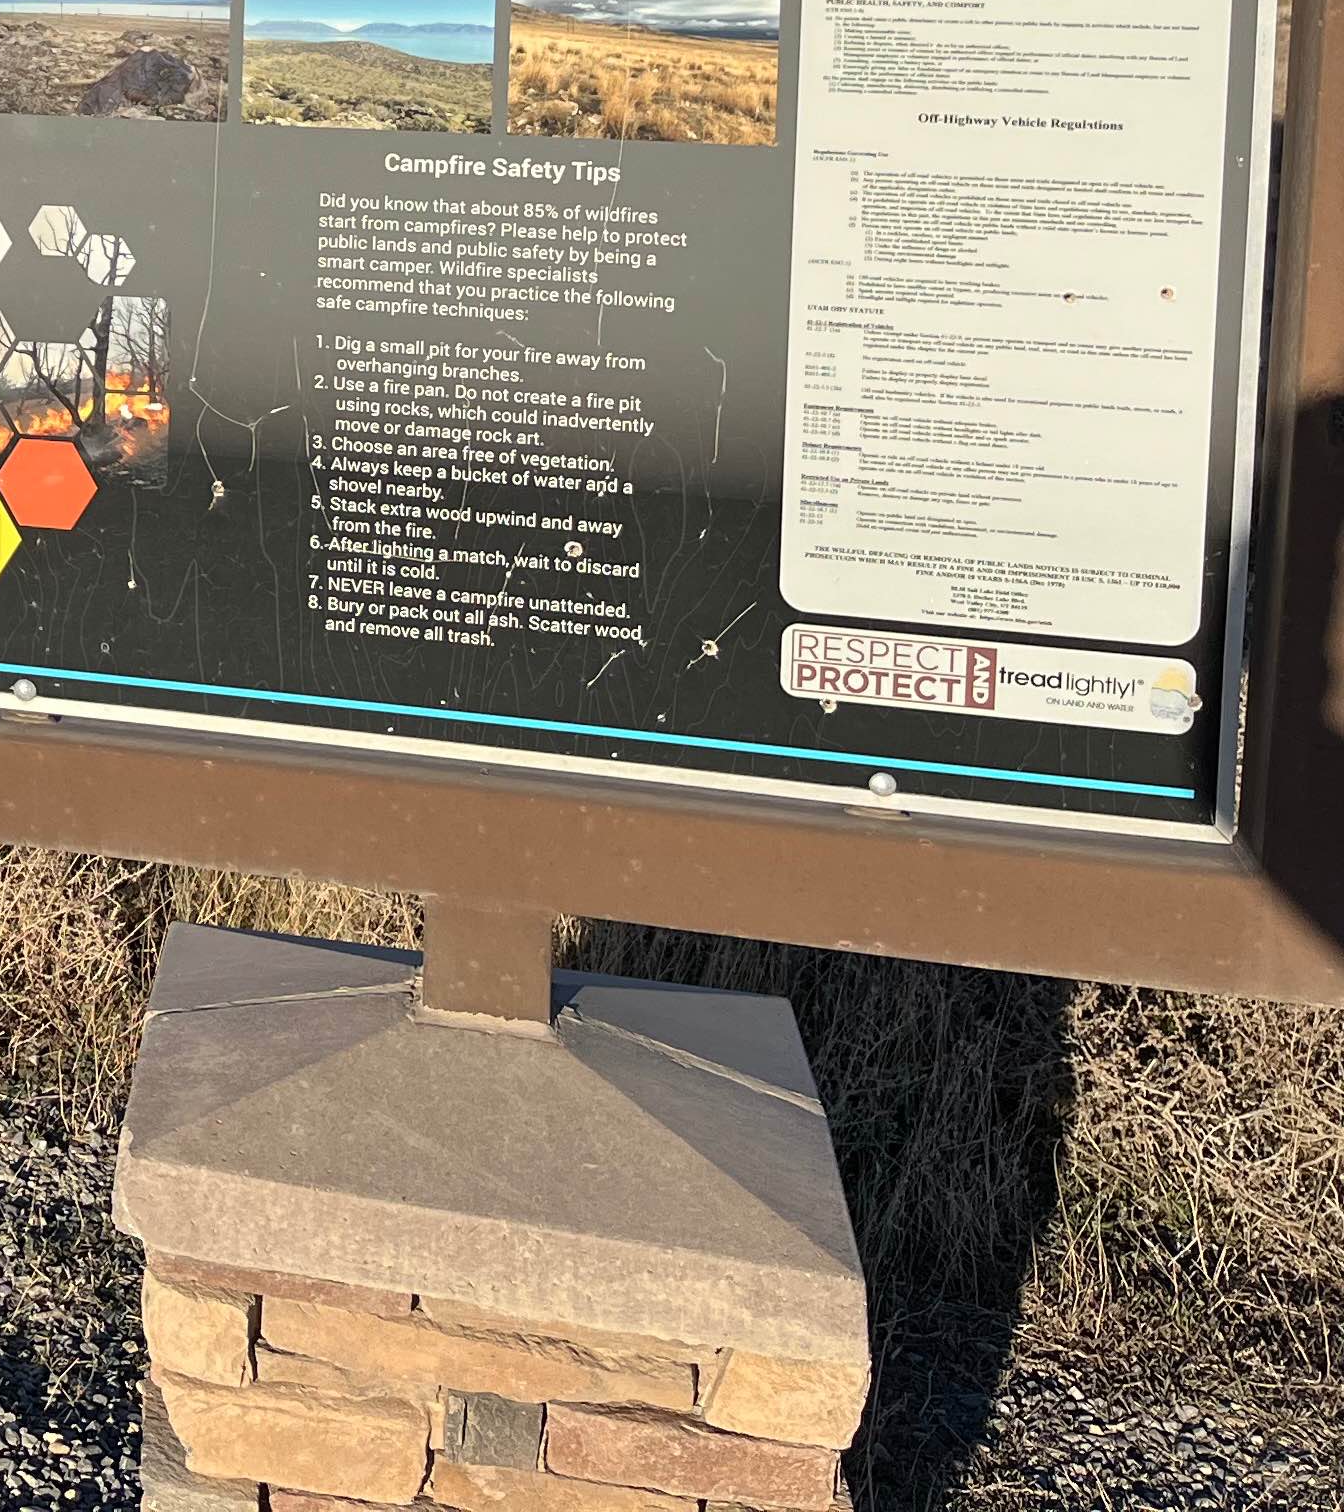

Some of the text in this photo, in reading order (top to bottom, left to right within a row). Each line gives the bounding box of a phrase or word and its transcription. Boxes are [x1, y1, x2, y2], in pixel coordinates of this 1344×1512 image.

[918, 113, 1123, 131] Off-Highway Vehicle Regulations
[385, 153, 620, 185] Campfire Safety Tips
[320, 192, 657, 225] Did you know that about 85% of wildfires
[798, 633, 963, 674] RESPECT
[796, 664, 962, 703] PROTECT
[972, 653, 992, 704] AND
[1045, 696, 1135, 712] ON LAND AND WATER
